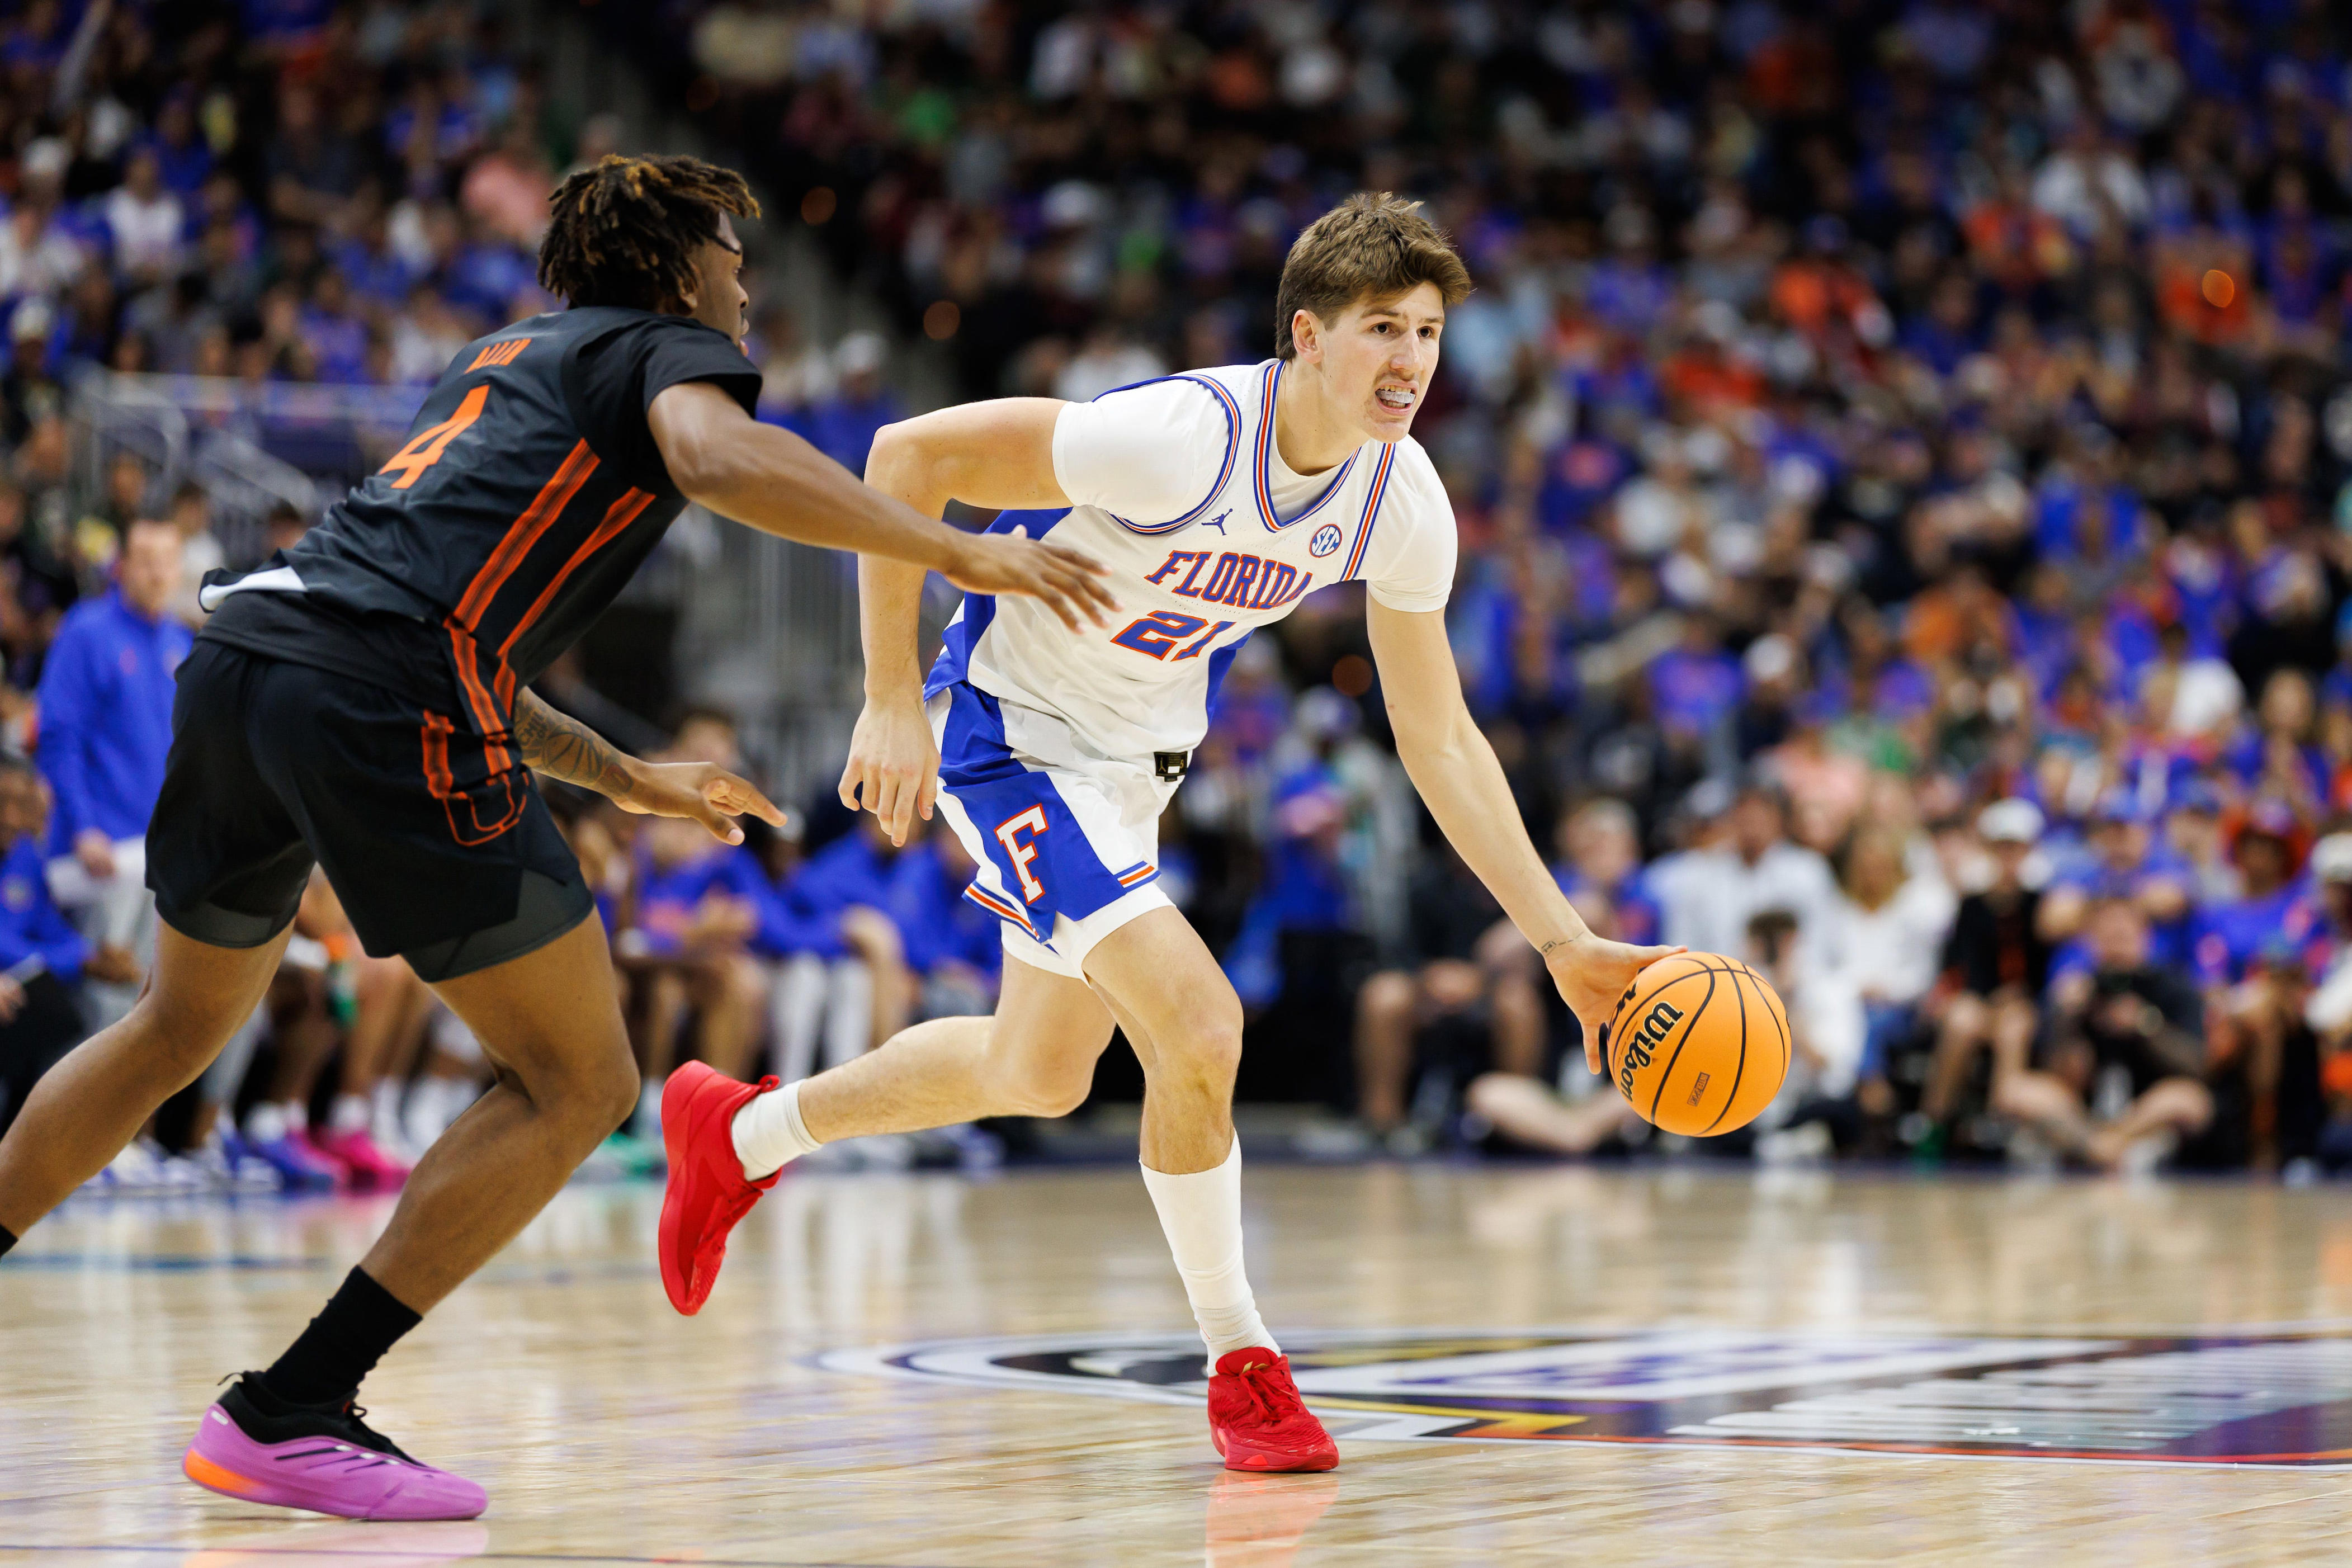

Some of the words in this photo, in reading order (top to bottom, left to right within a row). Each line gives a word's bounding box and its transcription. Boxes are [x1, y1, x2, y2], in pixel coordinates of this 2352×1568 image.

[379, 384, 490, 489] 4
[1311, 526, 1340, 556] SEC
[1110, 610, 1236, 662] 21
[993, 802, 1050, 905] F
[1620, 1000, 1685, 1102] Wilson
